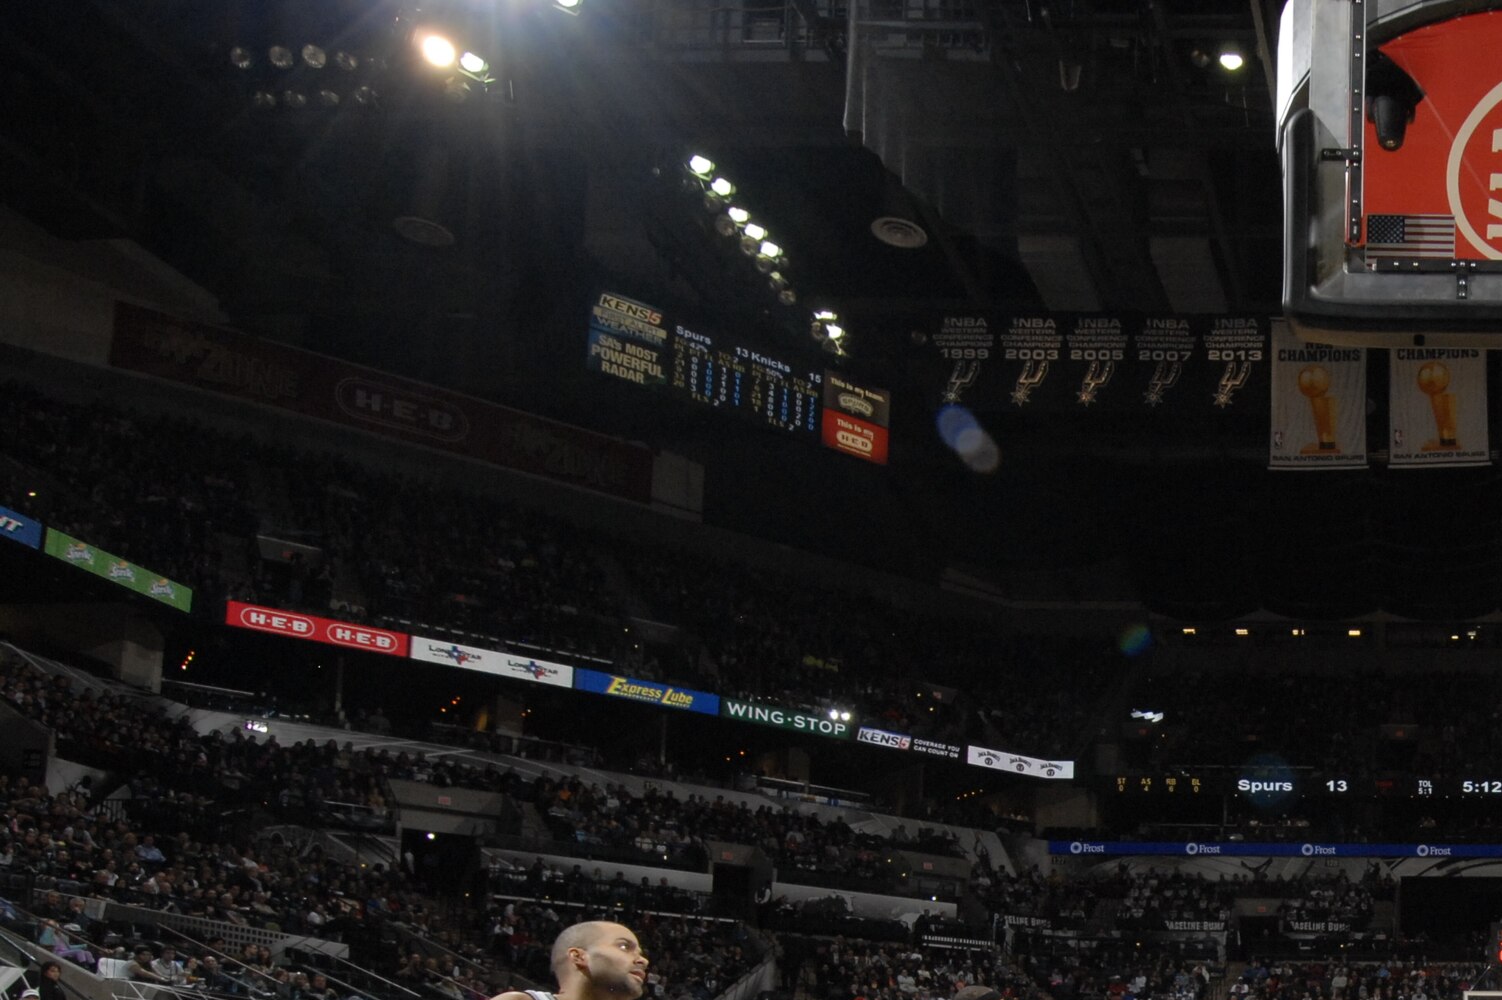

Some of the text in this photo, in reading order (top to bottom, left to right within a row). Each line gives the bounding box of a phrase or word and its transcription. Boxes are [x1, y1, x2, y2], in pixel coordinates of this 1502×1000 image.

[676, 325, 749, 358] Spurs 13
[625, 343, 658, 362] MOST
[1005, 350, 1059, 360] 2003
[1070, 350, 1124, 360] 2005
[1138, 350, 1191, 361] 2007
[1208, 350, 1263, 360] 2013
[1278, 349, 1361, 362] CHAMPIONS
[591, 344, 665, 378] POWERFUL
[601, 360, 644, 384] RADAR
[751, 352, 822, 383] Knicks 15
[606, 676, 662, 699] Express
[661, 688, 693, 705] Lube
[913, 738, 960, 752] COVERAGE YOU
[927, 747, 948, 756] COUNT
[1237, 779, 1348, 794] Spurs 13
[1418, 780, 1433, 788] TOL
[1462, 780, 1502, 793] 5:12
[1418, 787, 1432, 795] 5:1
[1083, 843, 1104, 853] Frost
[1199, 844, 1221, 855] Frost
[1314, 844, 1336, 855] Frost
[1430, 846, 1451, 855] Frost
